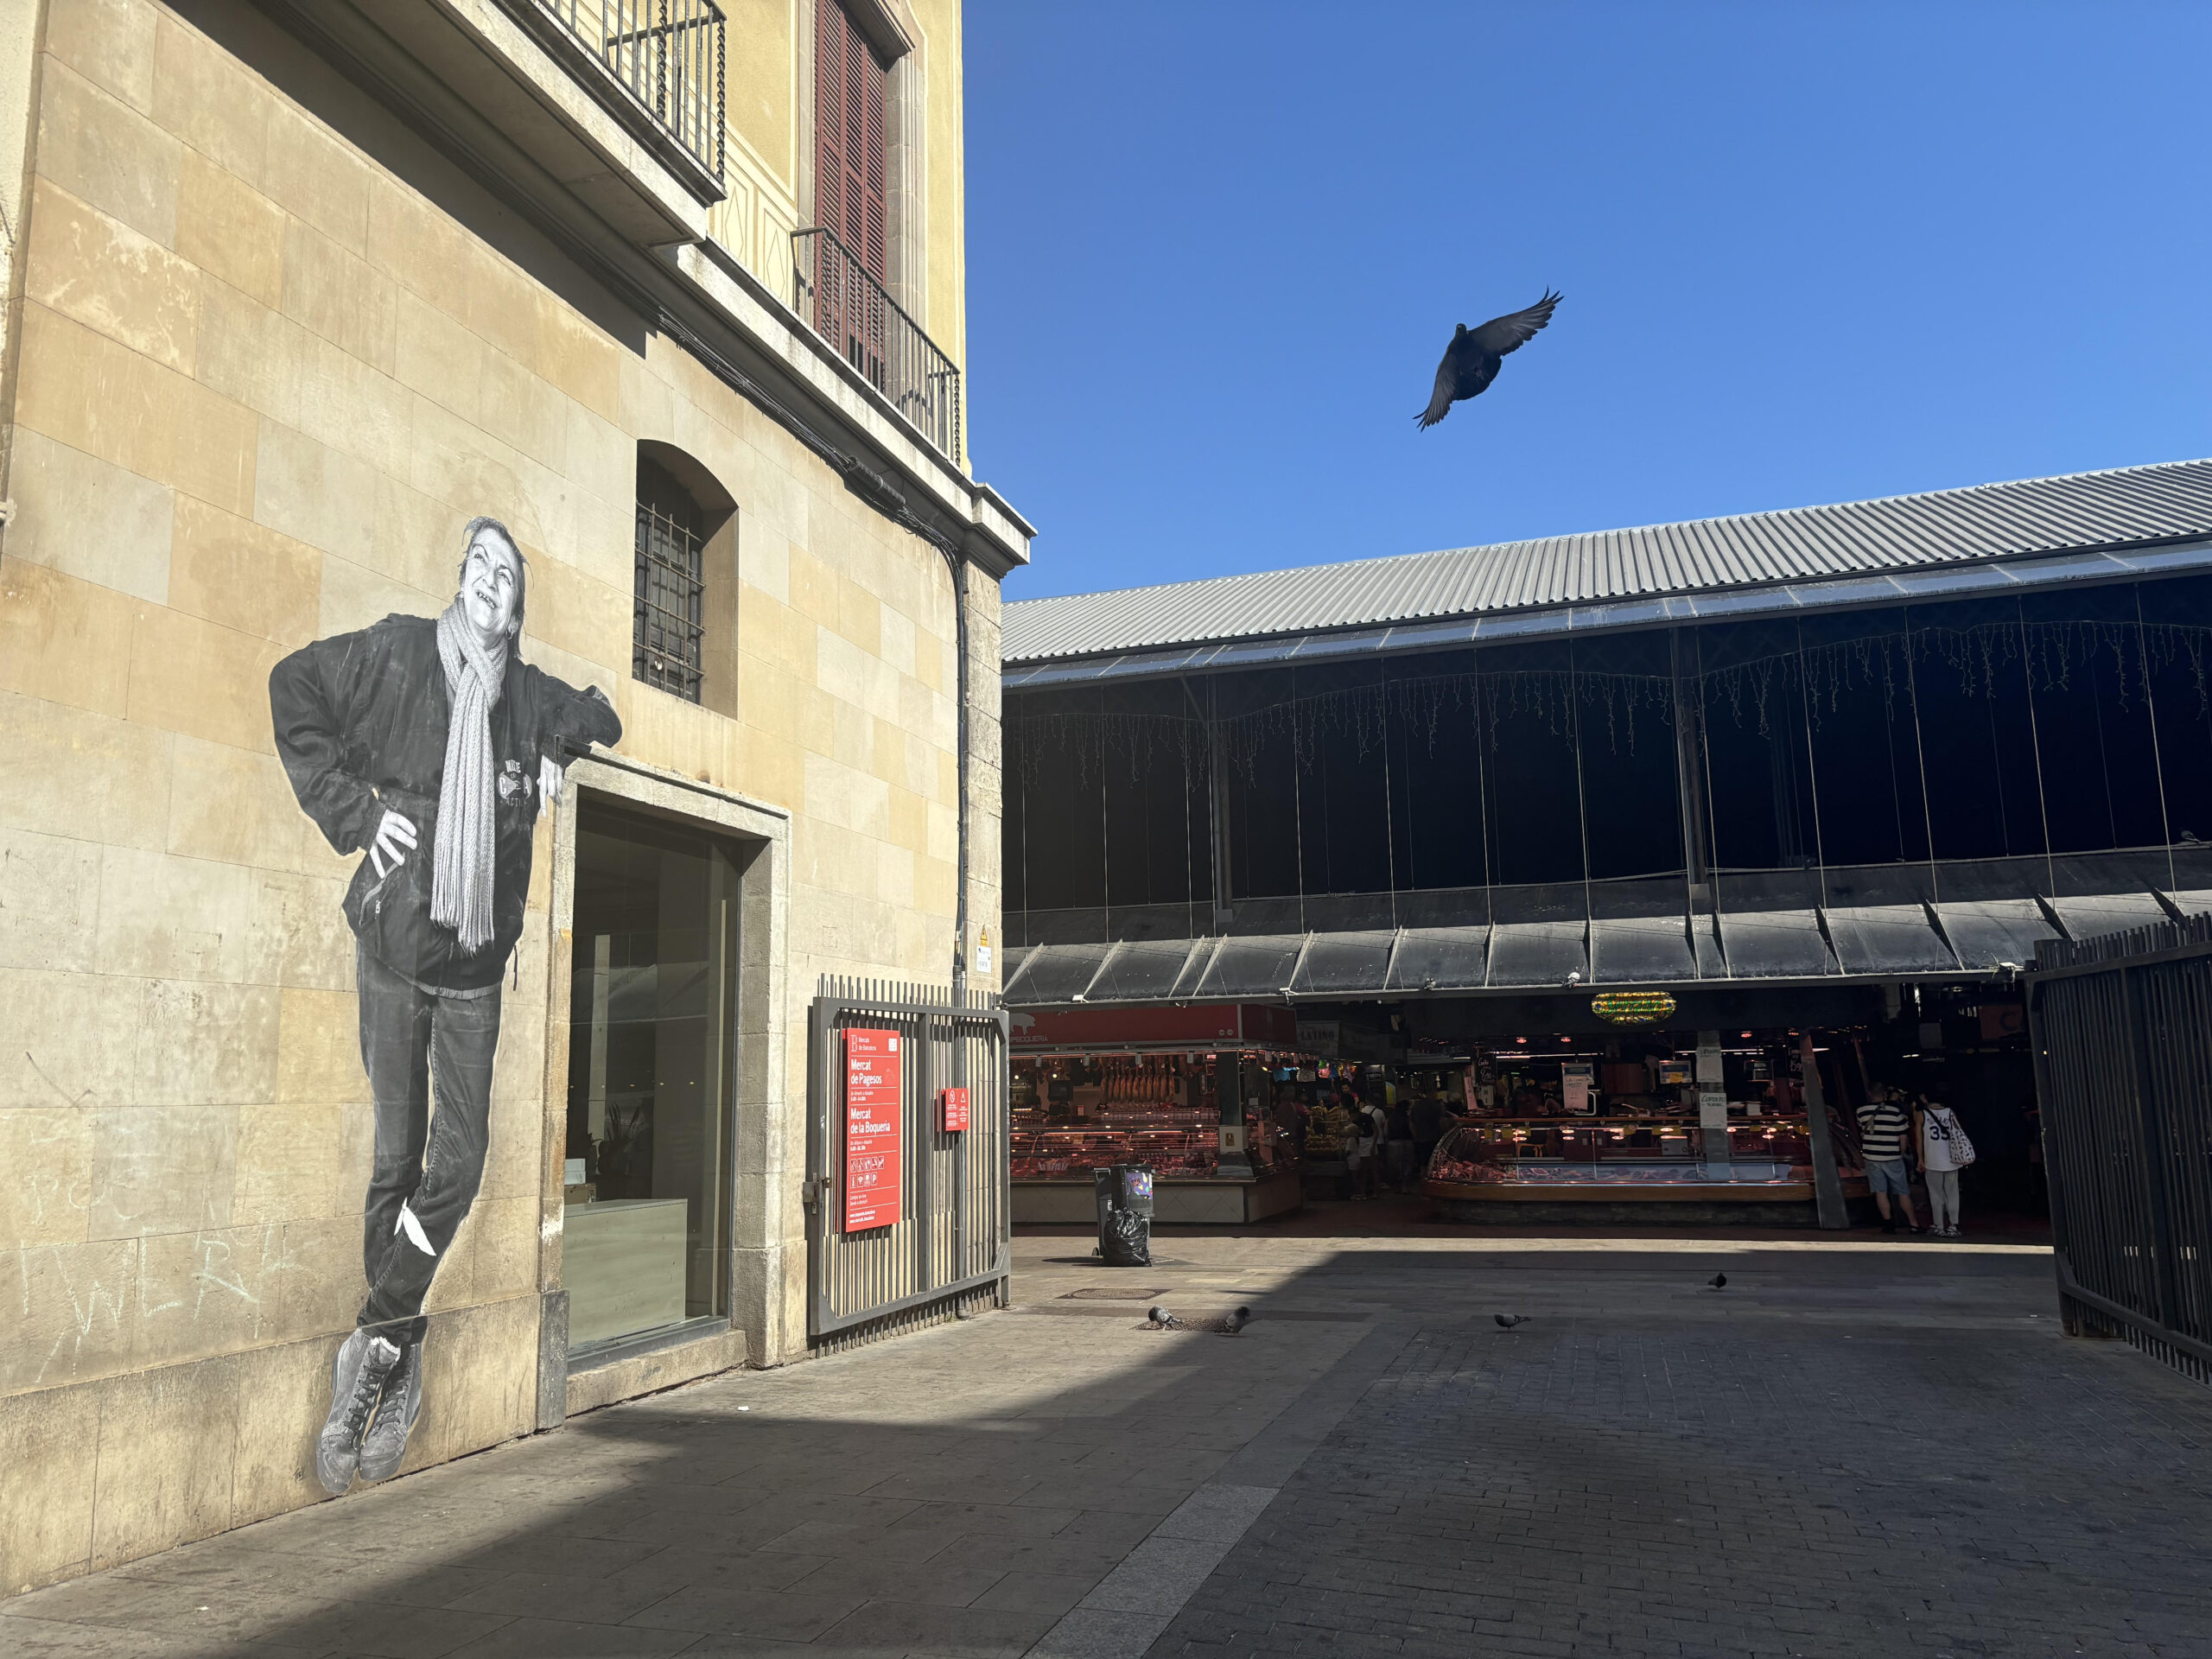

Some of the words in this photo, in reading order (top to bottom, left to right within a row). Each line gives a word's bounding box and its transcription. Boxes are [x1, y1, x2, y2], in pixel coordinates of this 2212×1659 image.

[851, 1058, 871, 1071] Mercat
[850, 1072, 858, 1084] de
[859, 1072, 882, 1087] Pagesos
[851, 1108, 871, 1120] Mercat
[850, 1122, 858, 1134] de
[859, 1122, 864, 1134] la
[866, 1120, 891, 1136] Boqueria
